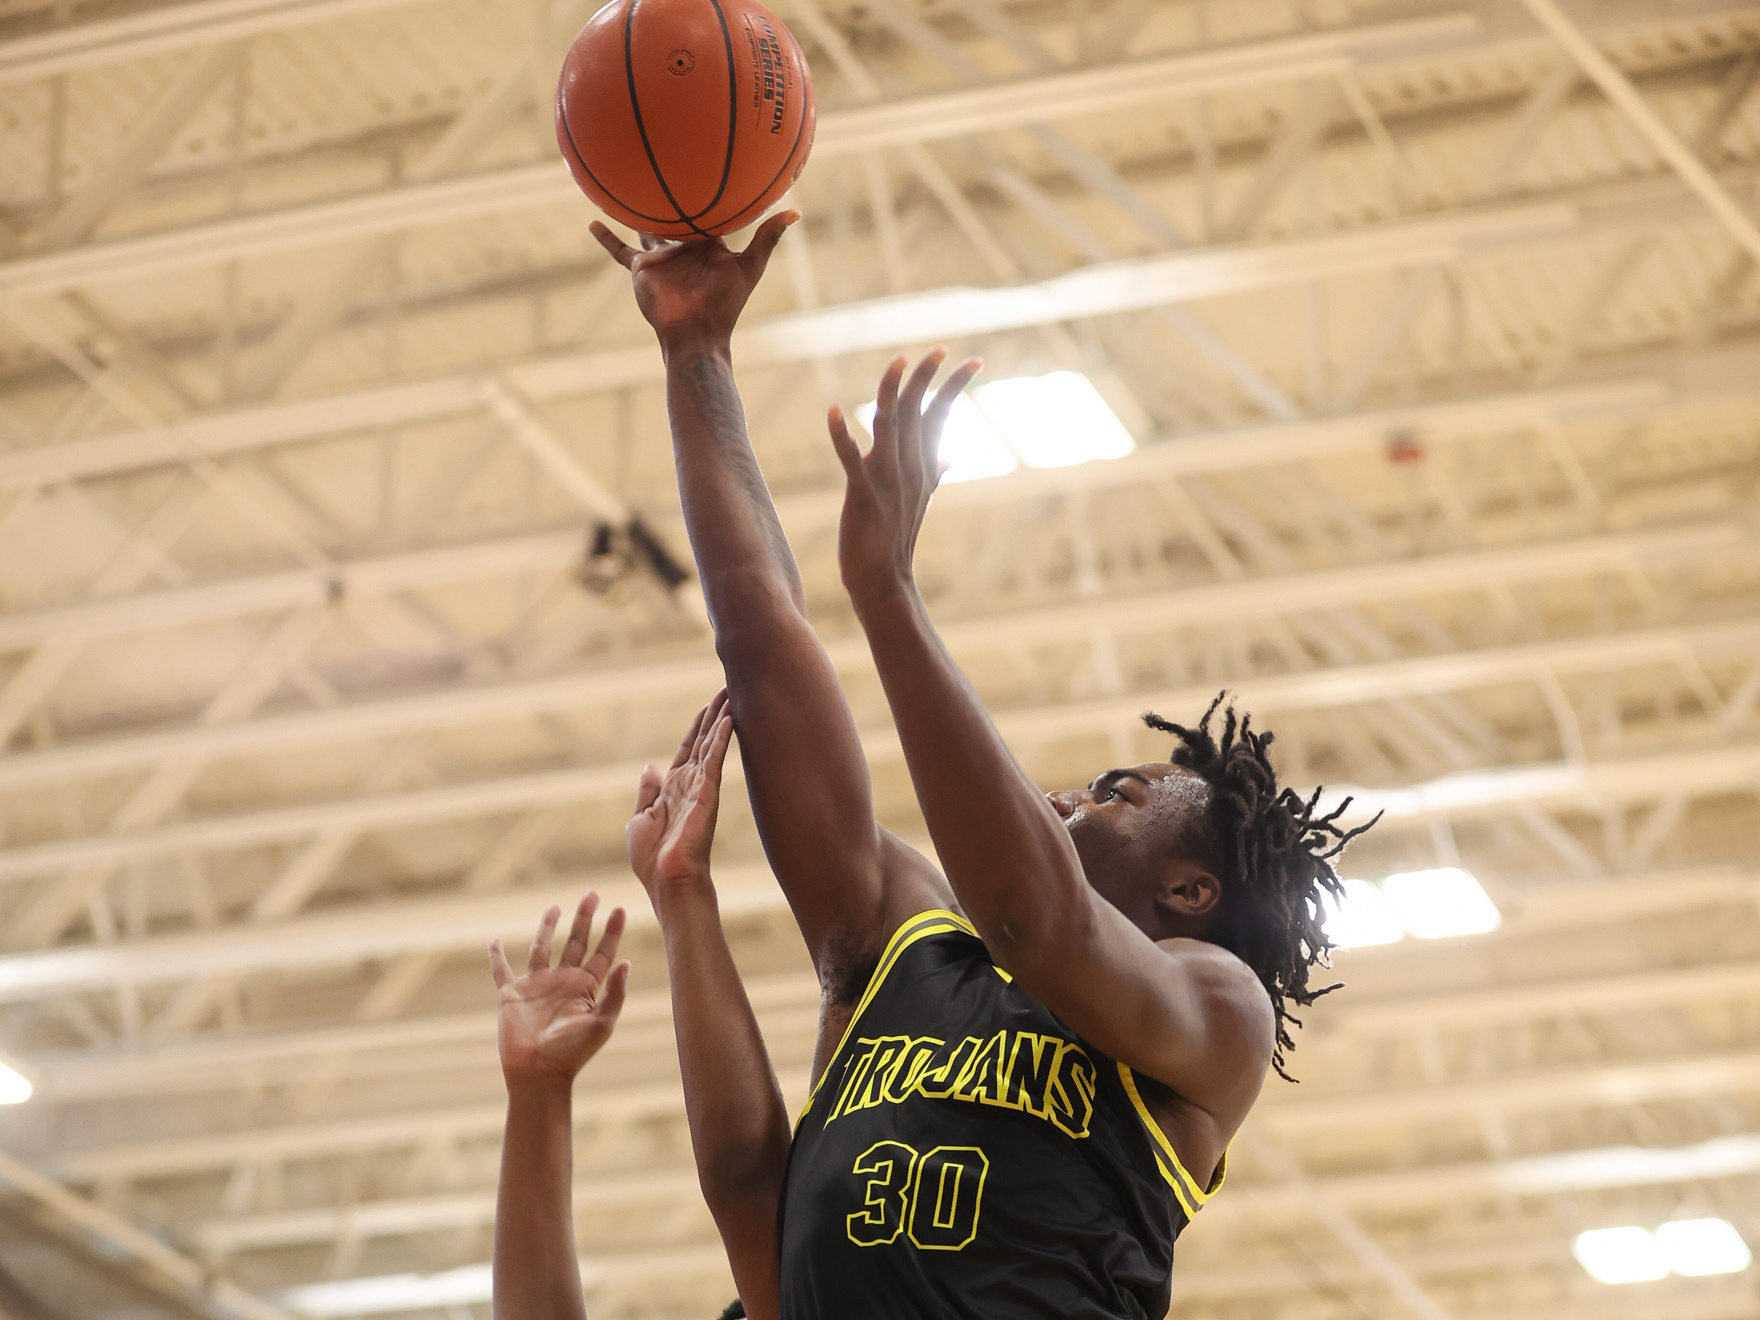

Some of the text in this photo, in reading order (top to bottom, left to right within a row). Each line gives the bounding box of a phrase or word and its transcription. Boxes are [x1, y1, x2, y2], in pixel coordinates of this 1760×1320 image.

[758, 37, 774, 101] SERIES
[760, 16, 785, 134] COMPETITION
[823, 1029, 1098, 1139] TROJANS
[846, 1140, 990, 1252] 30
